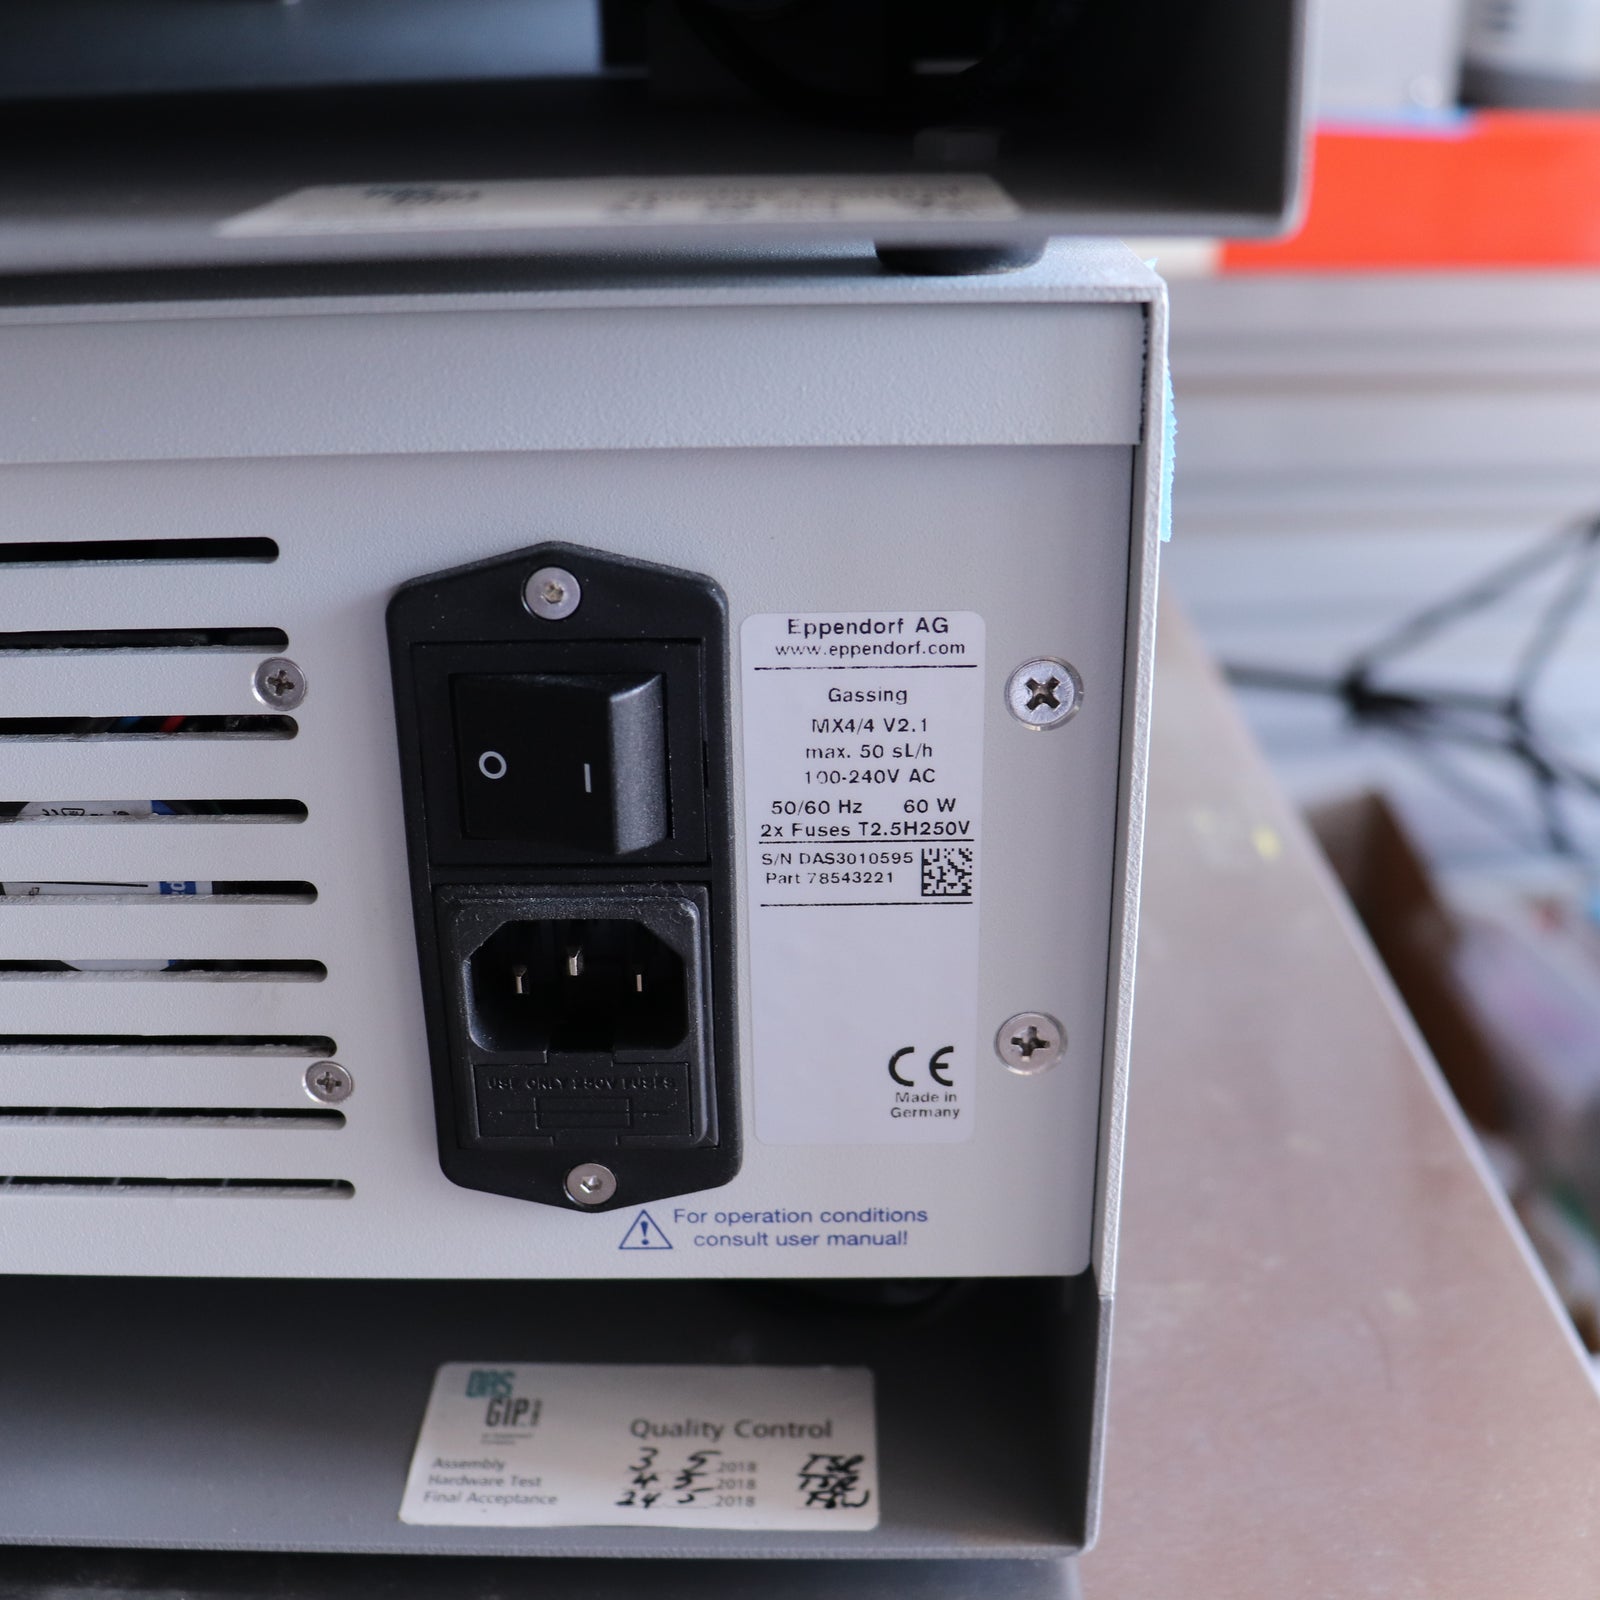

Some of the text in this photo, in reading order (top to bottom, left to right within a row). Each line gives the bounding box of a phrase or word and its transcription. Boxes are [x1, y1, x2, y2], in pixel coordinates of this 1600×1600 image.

[788, 617, 949, 639] Eppendorf AG
[775, 641, 965, 658] www.eppendorf.com
[828, 687, 907, 705] Gassing
[812, 718, 928, 735] MX4/4 V2.1
[806, 743, 933, 760] max. 50 sL/h
[805, 768, 936, 785] 100-240V AC
[771, 798, 956, 815] 50/60 Hz 60 W
[761, 821, 970, 838] 2x Fuses T2.5H250V
[762, 852, 914, 866] S/N DAS3010595
[766, 871, 893, 884] Part 78543221
[888, 1046, 954, 1087] CE
[895, 1091, 957, 1103] Made in
[890, 1106, 960, 1120] Germany
[674, 1207, 928, 1227] For operation conditions
[694, 1230, 908, 1247] consult user manual!
[630, 1418, 833, 1442] Quality Control
[433, 1457, 506, 1472] Assembly
[717, 1461, 757, 1473] 2018
[428, 1475, 542, 1487] Hardware Test
[716, 1478, 756, 1490] 2018
[423, 1491, 558, 1506] Final Acceptance
[715, 1495, 756, 1507] 2018
